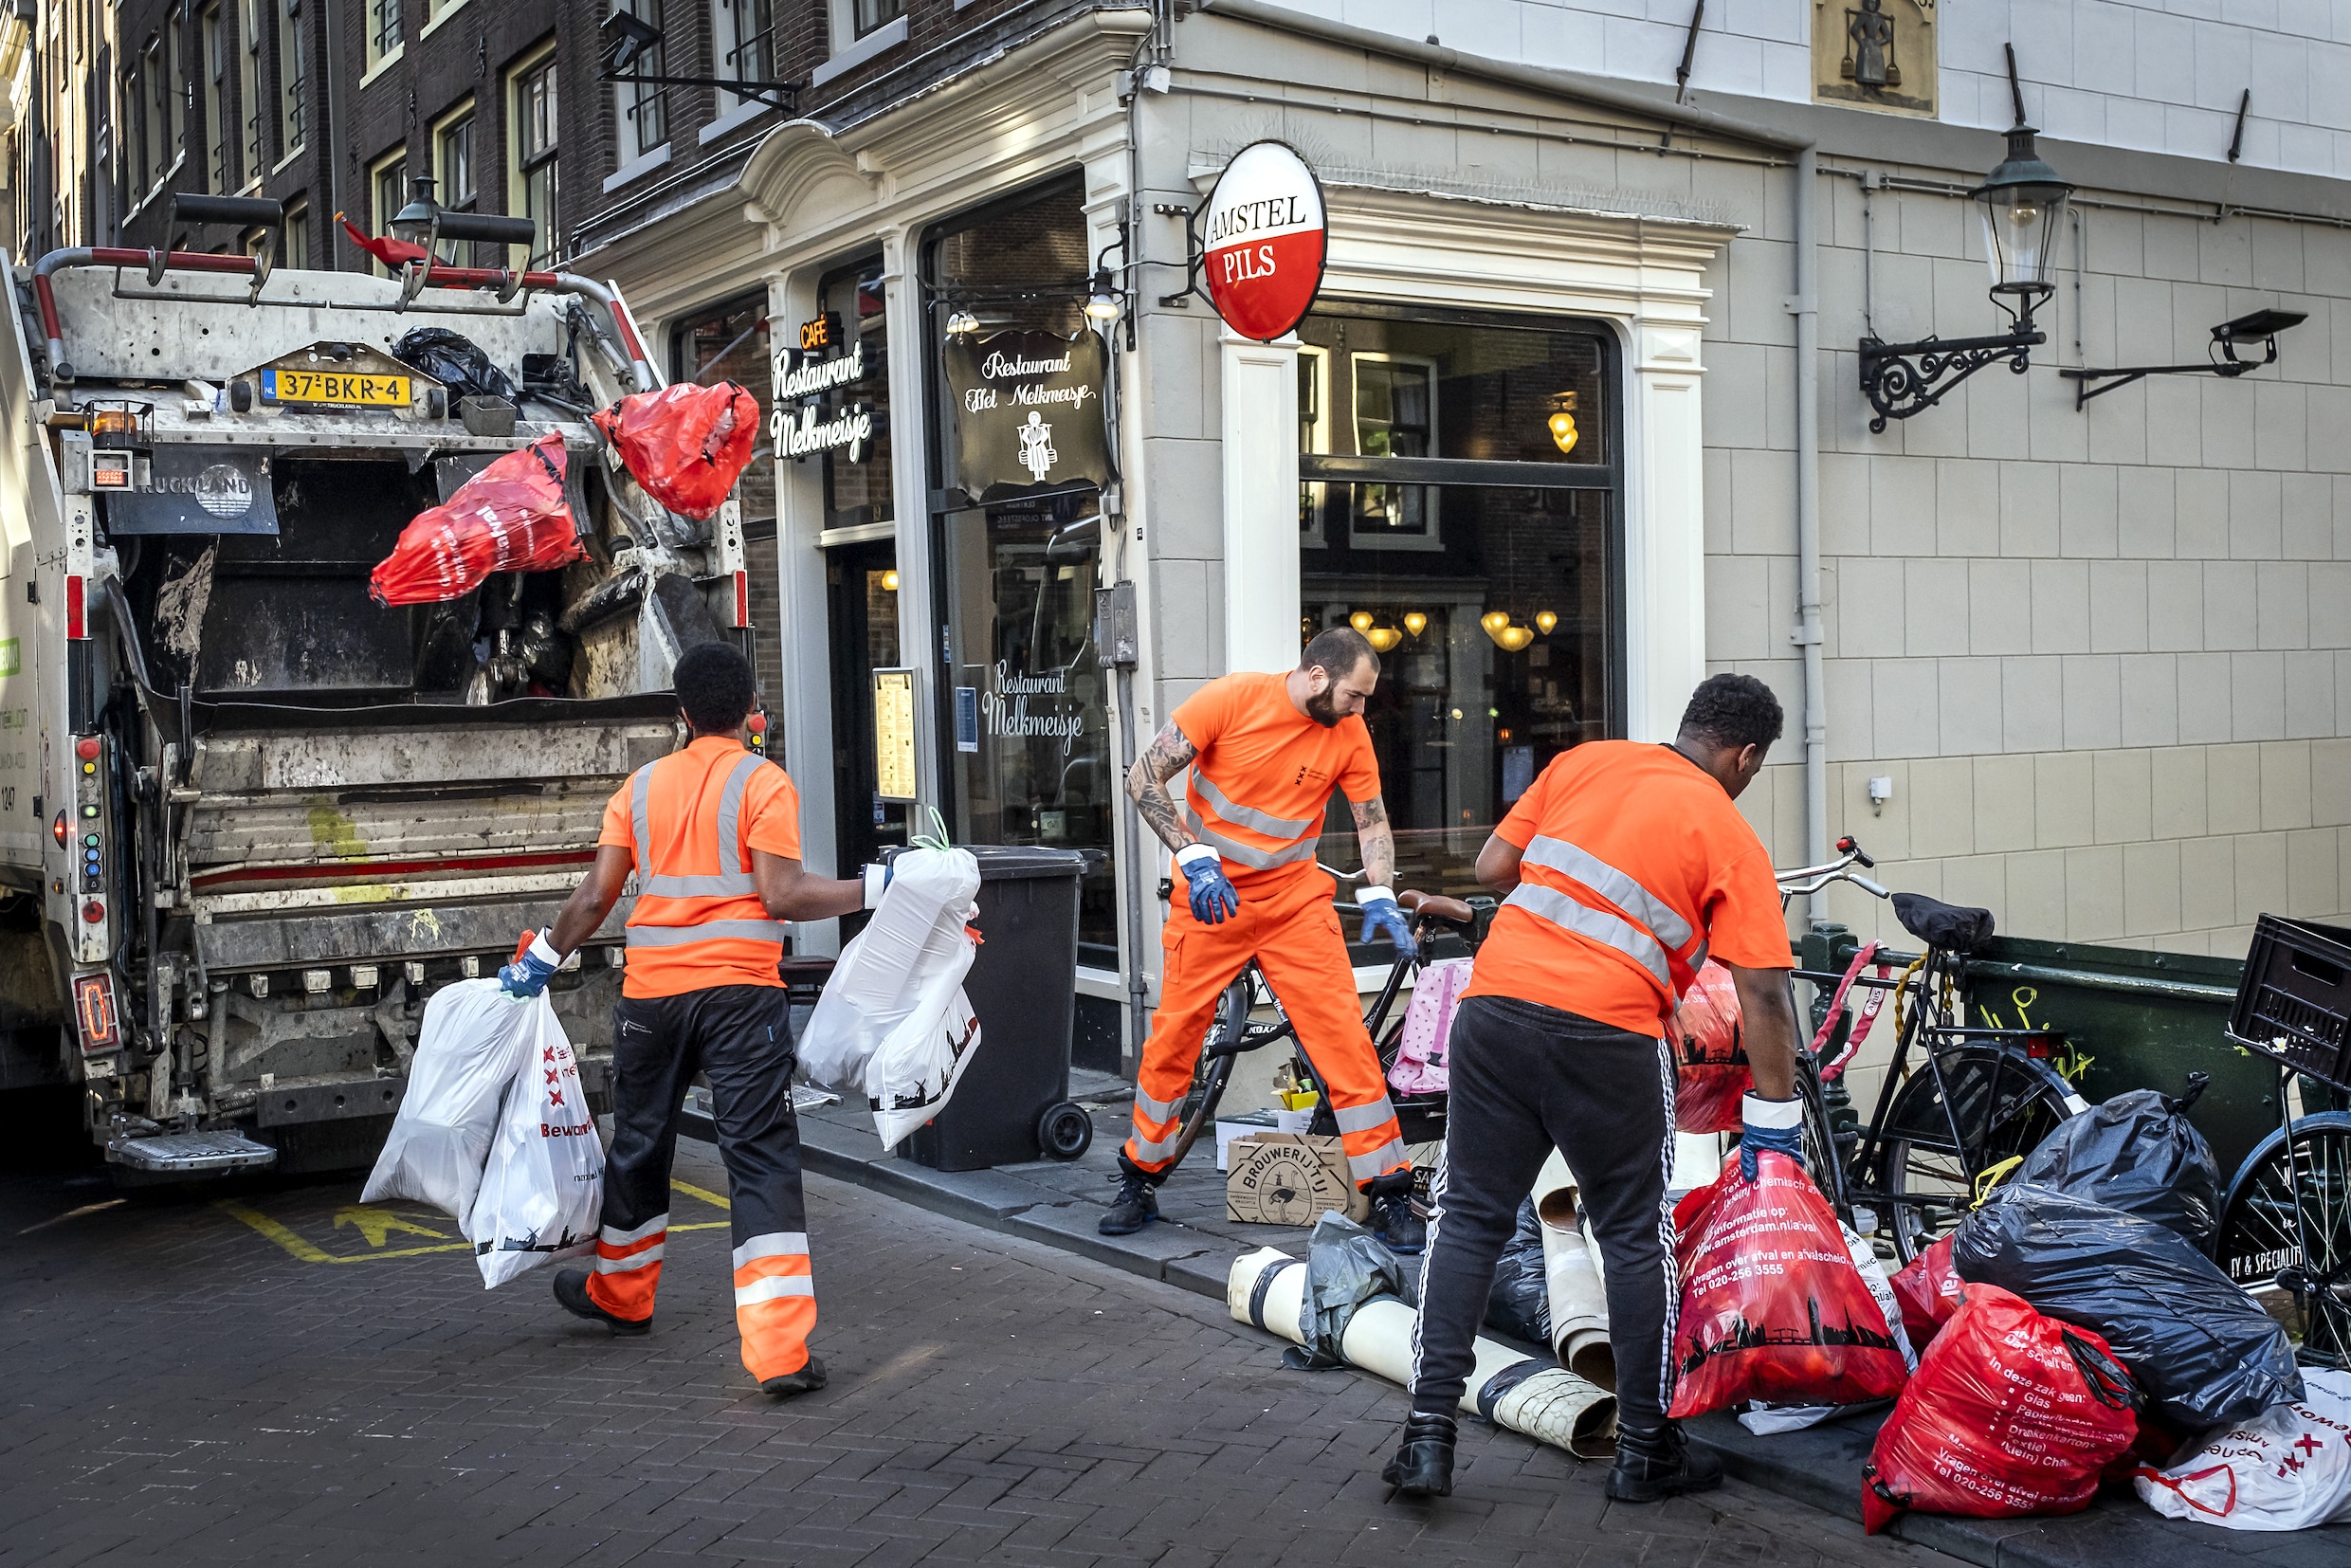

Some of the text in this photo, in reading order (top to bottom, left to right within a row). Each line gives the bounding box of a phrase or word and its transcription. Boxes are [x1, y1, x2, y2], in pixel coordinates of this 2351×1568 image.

[1211, 195, 1306, 244] AMSTEL
[1222, 245, 1276, 283] PILS
[800, 314, 829, 350] CAFÉ
[772, 338, 864, 402] Restaurant
[981, 350, 1071, 380] Restaurant
[964, 383, 1097, 414] Het Melkmeisje
[769, 401, 872, 465] Melkmeisje
[994, 659, 1066, 695] Restaurant
[981, 691, 1084, 757] Melkmeisje
[1, 786, 15, 811] 1247
[1692, 1264, 1723, 1287] Vragen
[1725, 1254, 1748, 1270] over
[1751, 1249, 1778, 1263] afval
[1781, 1250, 1795, 1260] en
[1692, 1264, 1784, 1299] Tel 020-256 3555
[1989, 1356, 2002, 1372] In
[2003, 1367, 2033, 1388] deze
[2033, 1382, 2057, 1398] zak
[2060, 1360, 2074, 1372] en
[2024, 1392, 2051, 1409] Glas
[1939, 1447, 1977, 1477] Vragen
[1933, 1460, 1951, 1479] Tel
[1953, 1473, 2002, 1502] 020-256
